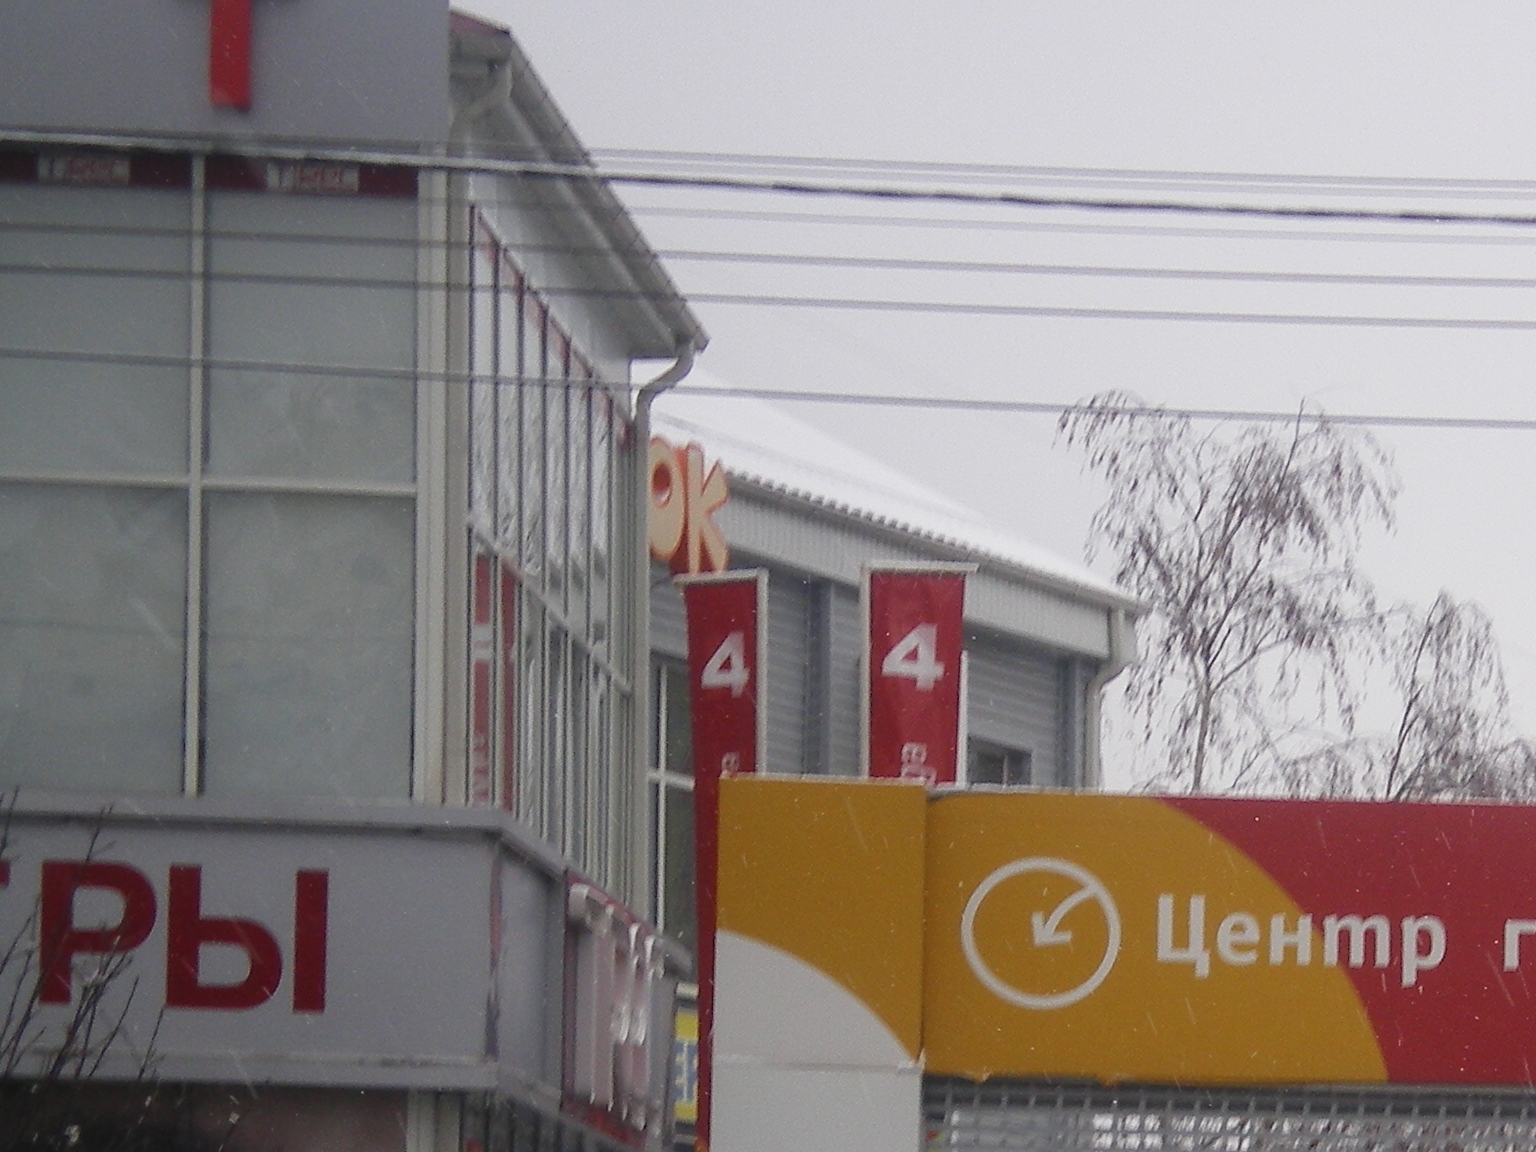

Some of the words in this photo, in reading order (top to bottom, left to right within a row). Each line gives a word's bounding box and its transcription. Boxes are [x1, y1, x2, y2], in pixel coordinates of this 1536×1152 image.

[700, 630, 749, 698] 4
[881, 622, 946, 692] 4
[0, 860, 329, 1014] РЫ
[1156, 893, 1447, 987] Центр
